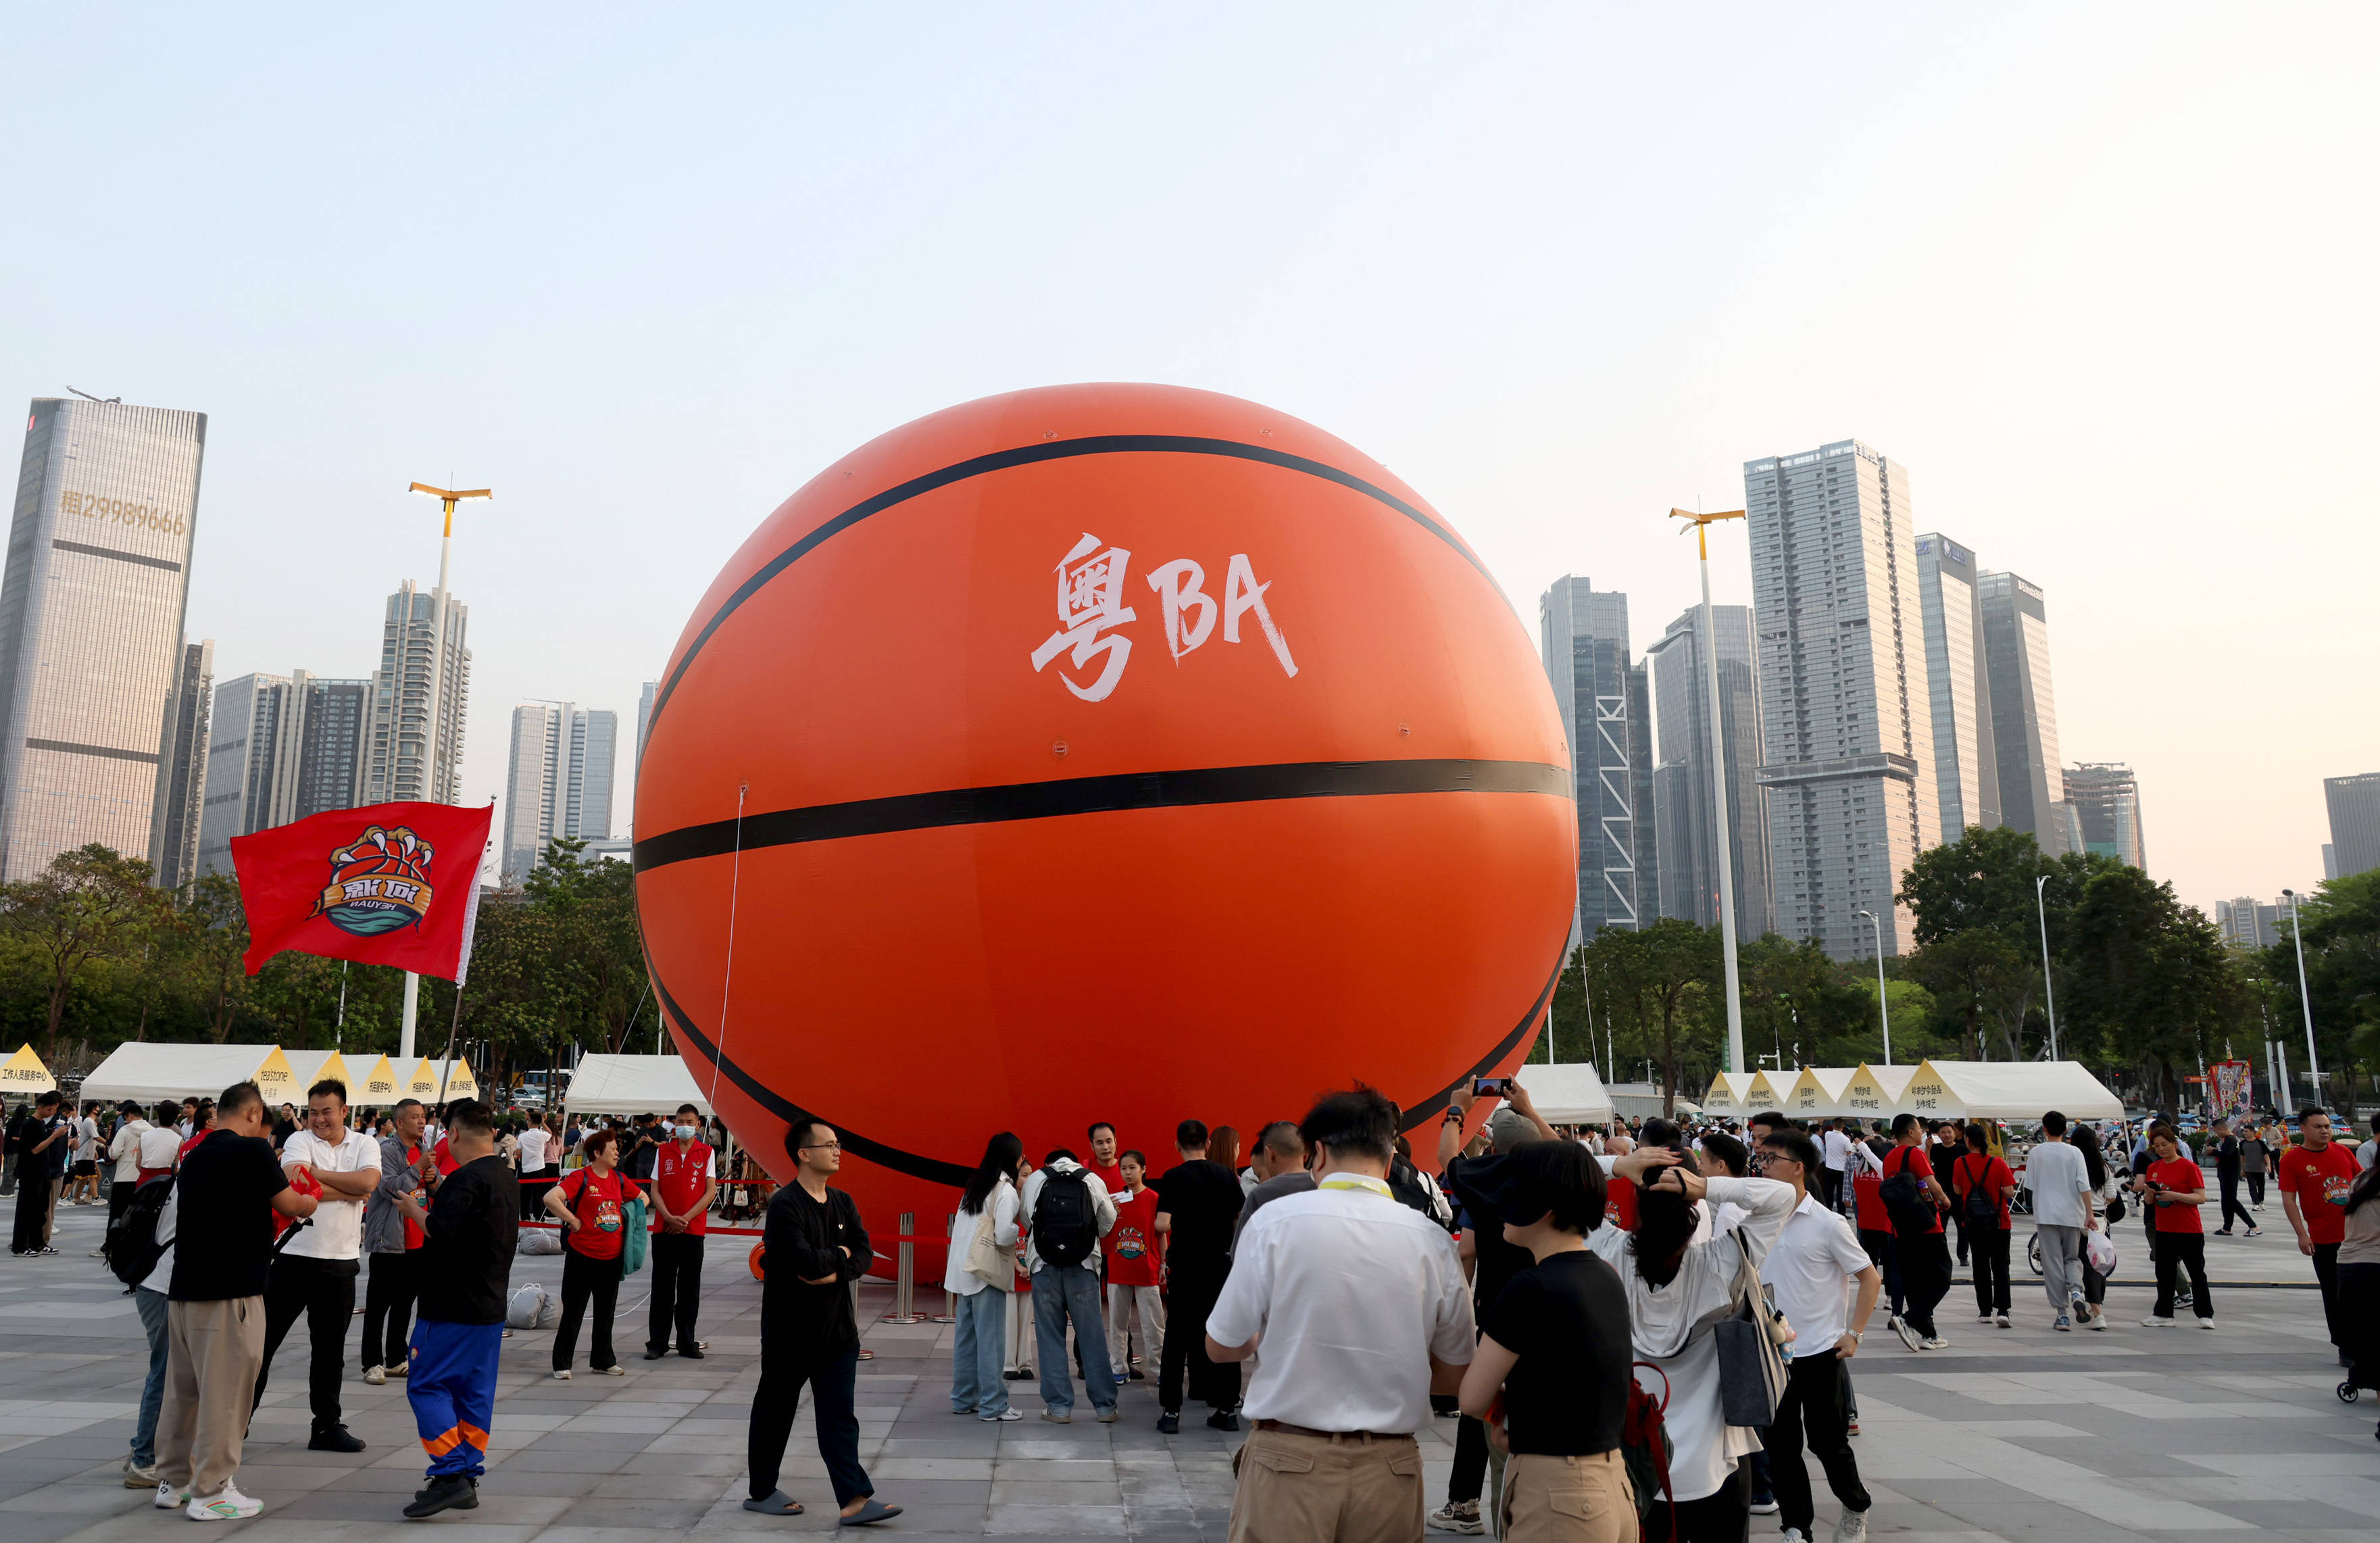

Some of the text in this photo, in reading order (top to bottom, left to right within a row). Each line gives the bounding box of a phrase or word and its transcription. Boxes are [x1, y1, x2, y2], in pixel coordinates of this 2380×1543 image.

[61, 490, 186, 536] 租29989666
[1031, 532, 1299, 703] 粤BA
[2, 1069, 47, 1081] 工作人员服务中心
[368, 1081, 393, 1093] 市民服务中心
[412, 1081, 433, 1093] 市民服务中心
